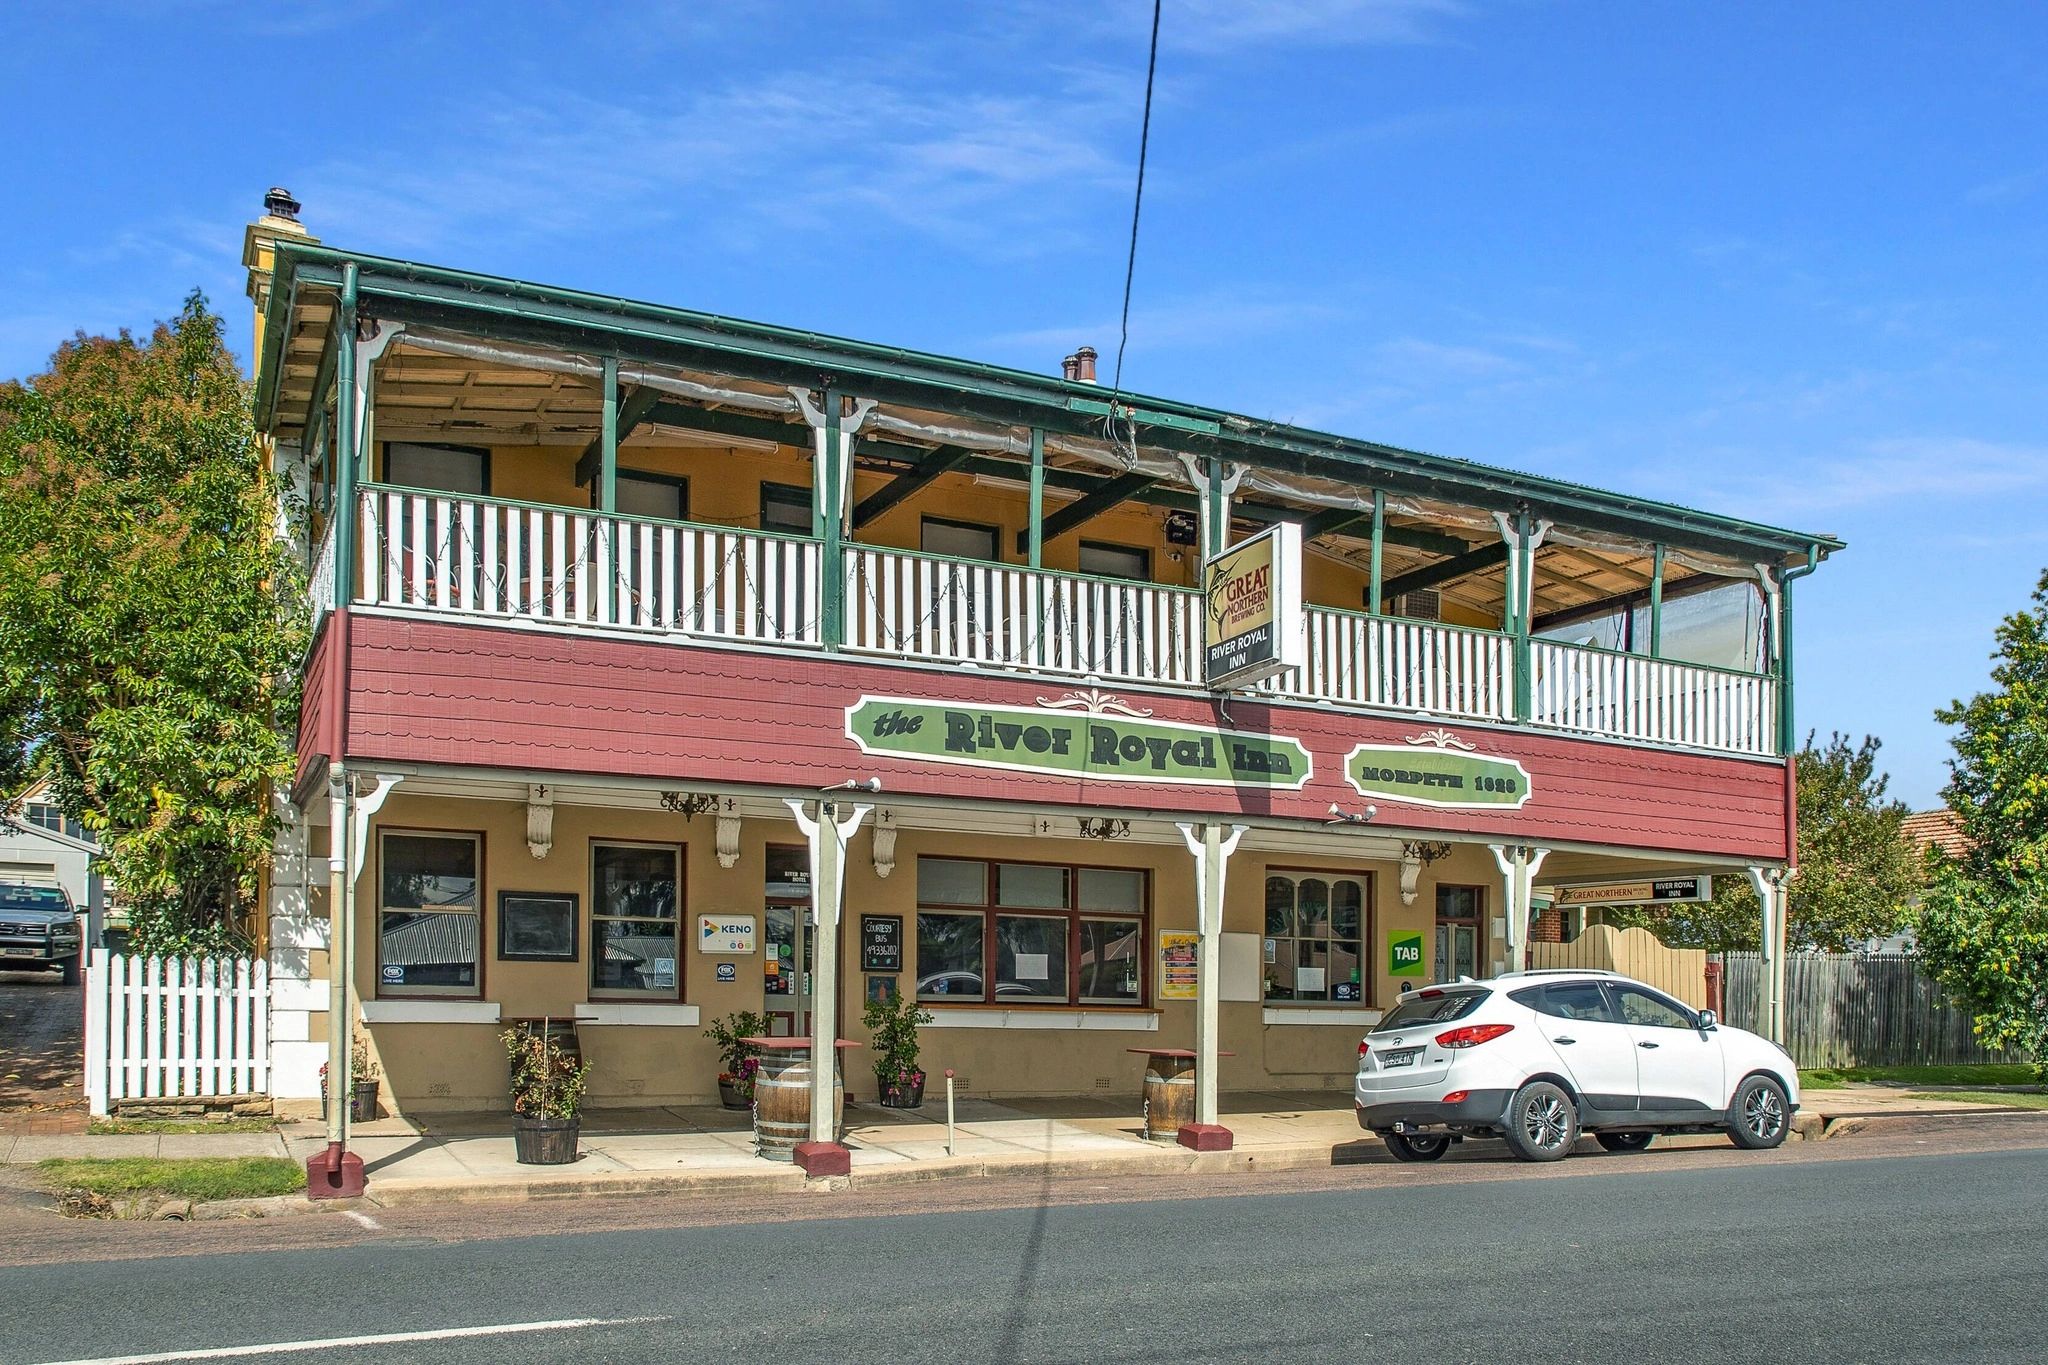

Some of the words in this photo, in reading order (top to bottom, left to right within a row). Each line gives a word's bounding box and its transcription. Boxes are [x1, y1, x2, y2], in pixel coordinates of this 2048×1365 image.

[1226, 563, 1270, 601] GREAT
[1227, 586, 1269, 616] NORTHERN
[1231, 607, 1255, 624] BREWING
[1211, 640, 1236, 661] RIVER
[1238, 628, 1268, 649] ROYAL
[1229, 651, 1247, 670] INN
[873, 710, 924, 738] the
[945, 711, 1072, 755] River
[1090, 725, 1217, 770] Royal
[1233, 743, 1292, 775] Inn
[1362, 766, 1464, 788] MORPETH
[1475, 776, 1517, 794] 1828
[1573, 890, 1594, 899] GREAT
[1595, 888, 1633, 898] NORTHERN
[1655, 882, 1673, 890] RIVER
[1673, 881, 1695, 889] ROYAL
[722, 925, 751, 934] KENO
[865, 924, 892, 933] COURTESY
[875, 934, 888, 943] BUS
[1394, 947, 1419, 960] TAB
